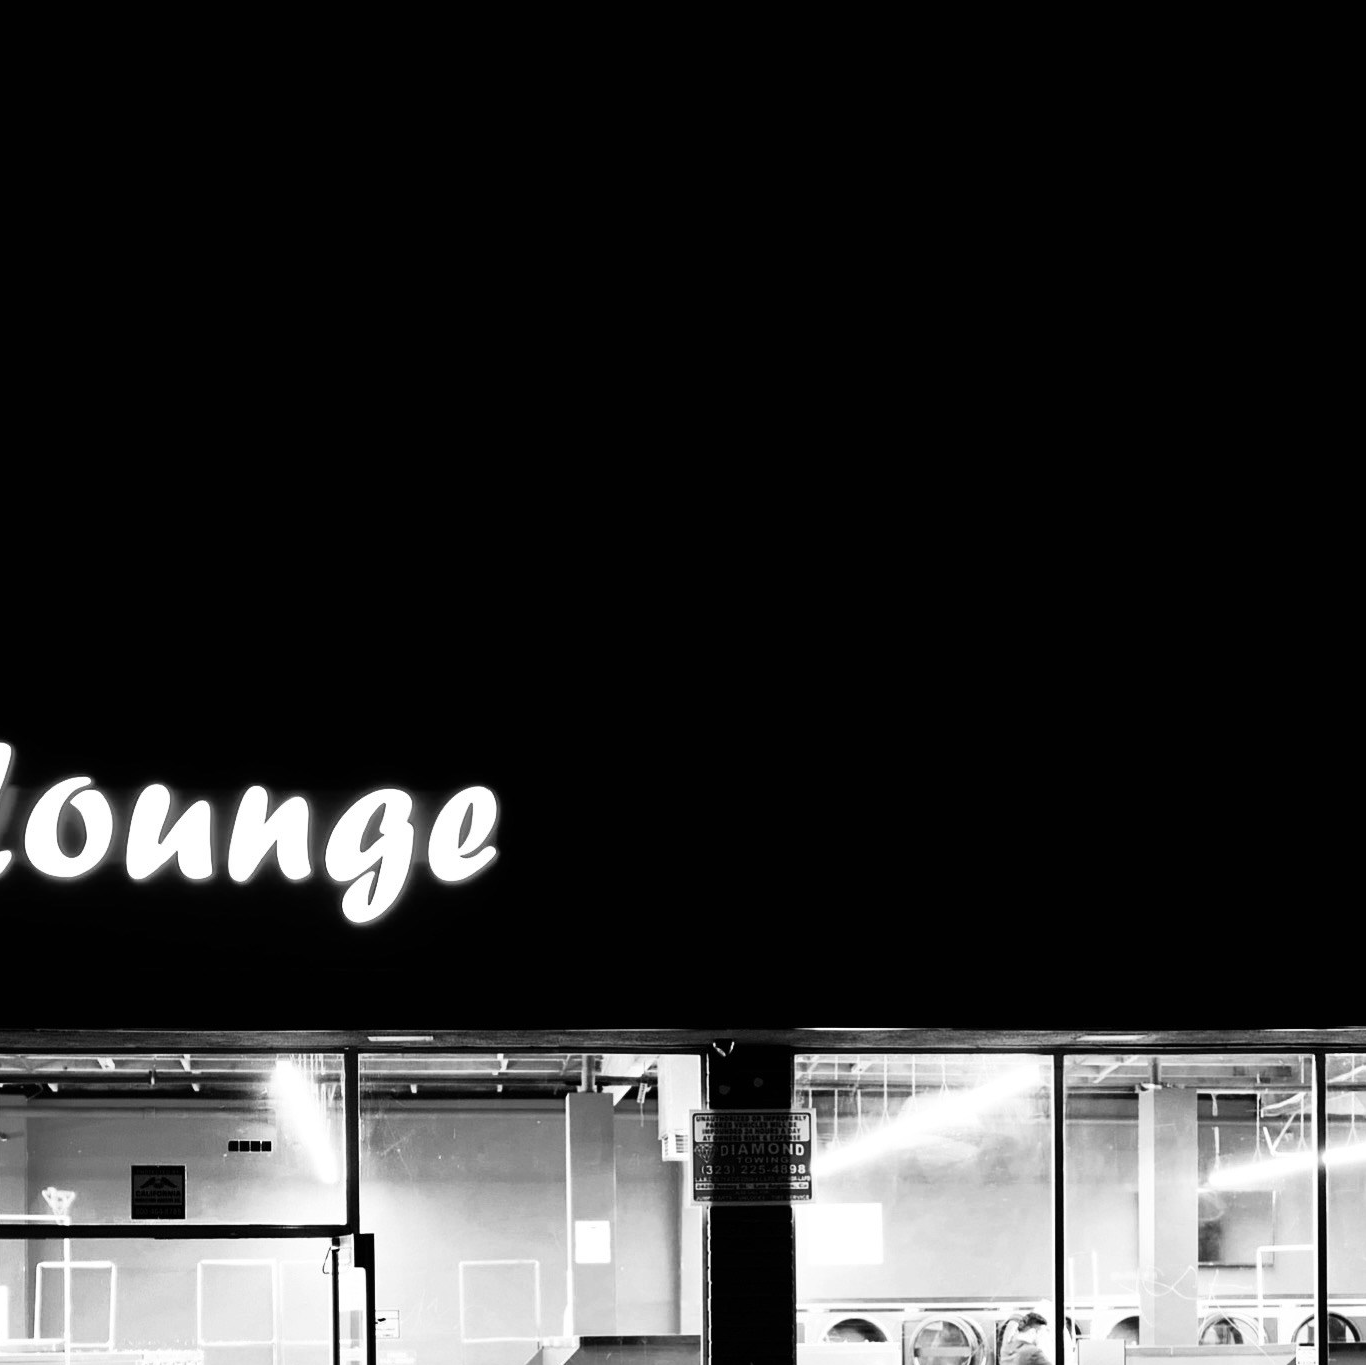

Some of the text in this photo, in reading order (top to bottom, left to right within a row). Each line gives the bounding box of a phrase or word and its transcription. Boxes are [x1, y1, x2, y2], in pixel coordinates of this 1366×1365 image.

[720, 1143, 805, 1156] DIAMOND
[701, 1163, 806, 1175] (323) 225-4898
